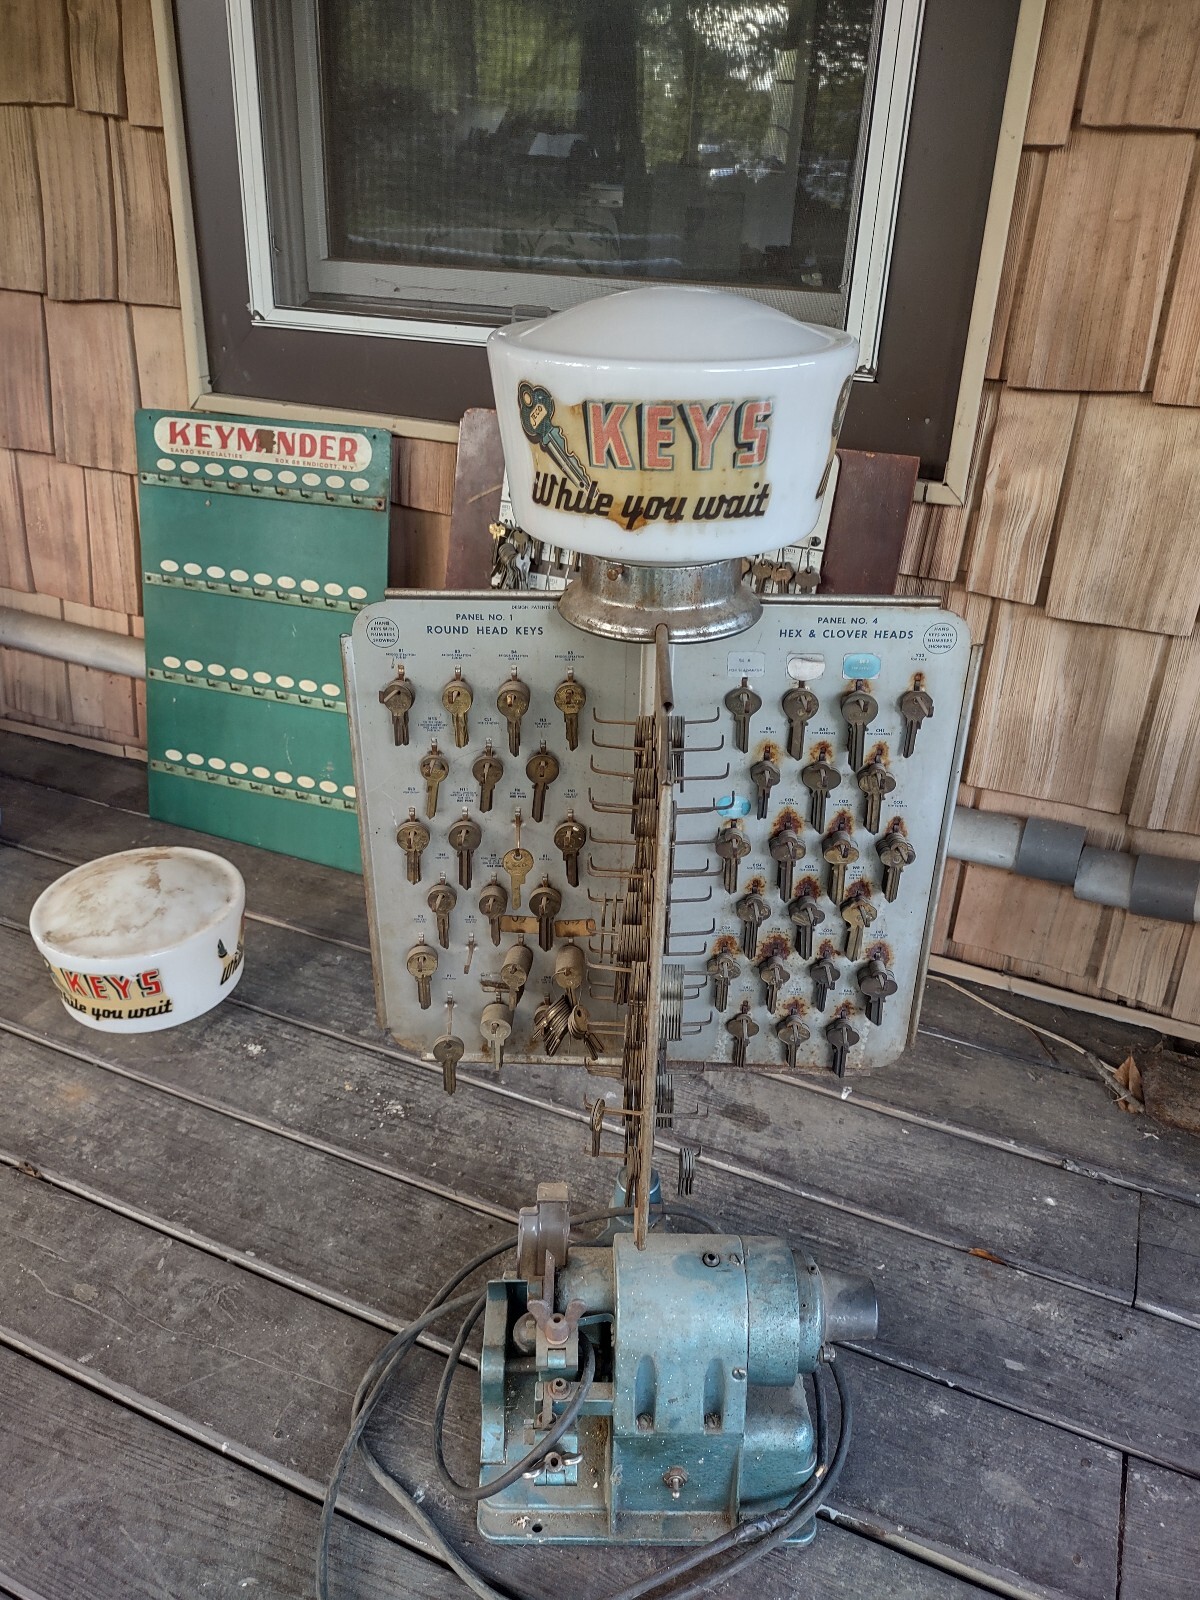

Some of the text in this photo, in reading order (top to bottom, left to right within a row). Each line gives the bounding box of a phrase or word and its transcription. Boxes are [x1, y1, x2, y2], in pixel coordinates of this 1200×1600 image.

[169, 421, 359, 462] KEYMNDER
[197, 450, 243, 459] SPECIALTIES
[533, 472, 770, 530] While you wait
[456, 613, 485, 622] PANEL
[488, 614, 505, 622] NO.
[817, 616, 879, 625] PANEL NO. 4
[426, 625, 544, 636] ROUND HEAD KEYS
[779, 629, 914, 639] HEX & CLOVER HEADS
[92, 1006, 123, 1021] you
[127, 999, 173, 1019] wait
